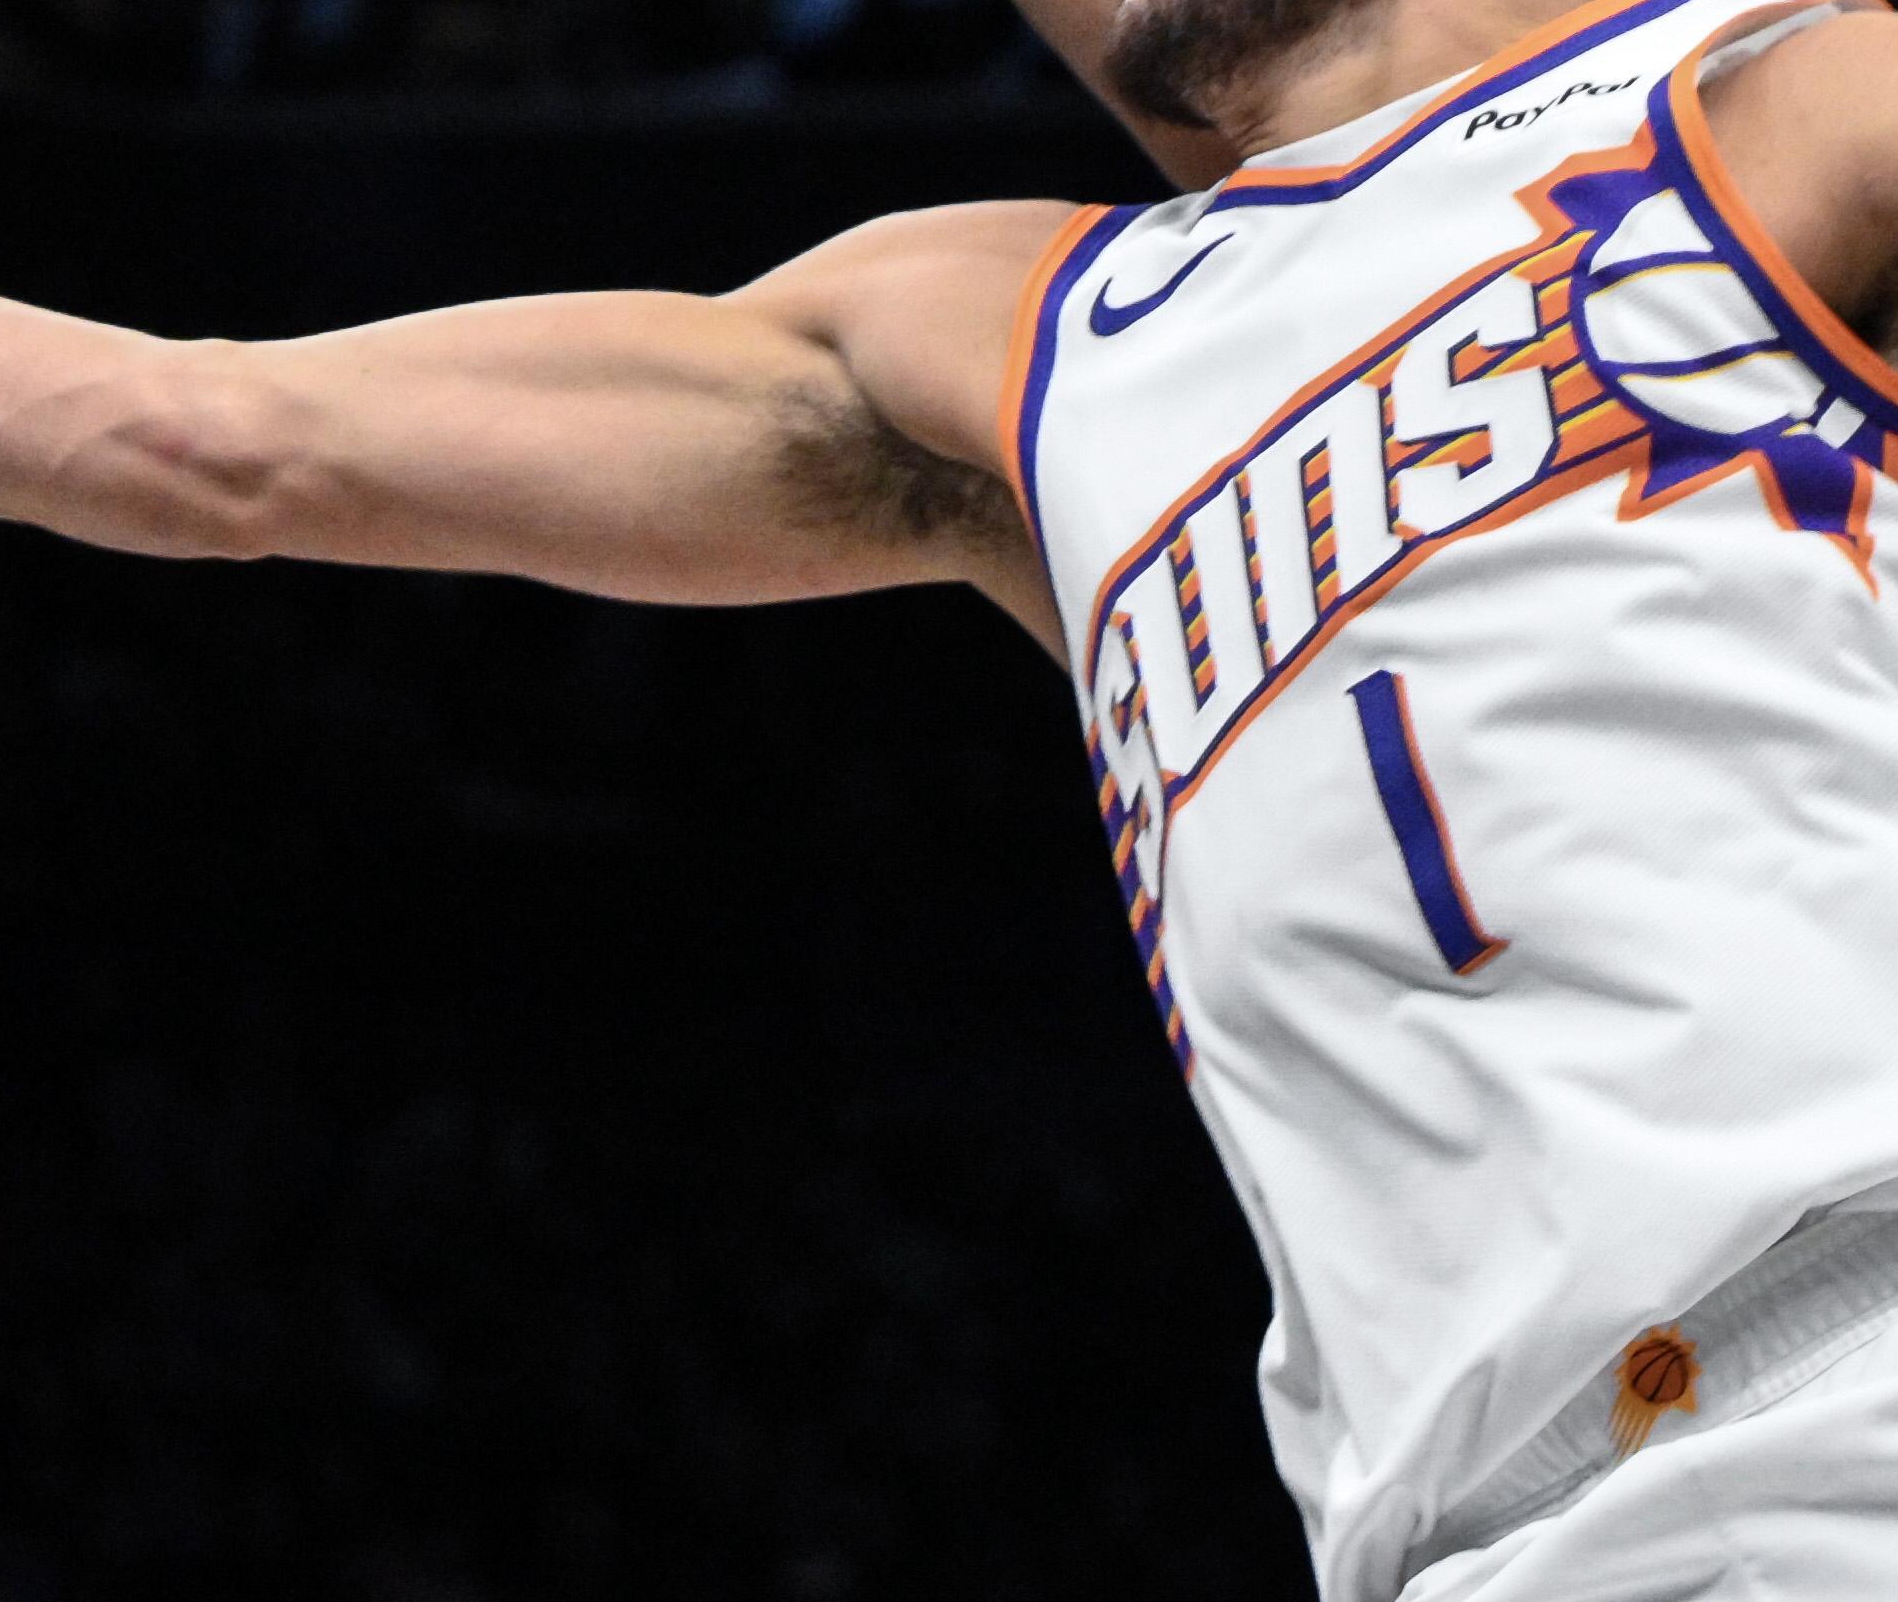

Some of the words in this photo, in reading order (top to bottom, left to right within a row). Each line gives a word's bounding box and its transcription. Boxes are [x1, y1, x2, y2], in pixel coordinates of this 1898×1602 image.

[1463, 74, 1642, 141] PayPal
[1091, 268, 1559, 900] SUNS
[1346, 668, 1509, 976] 1
